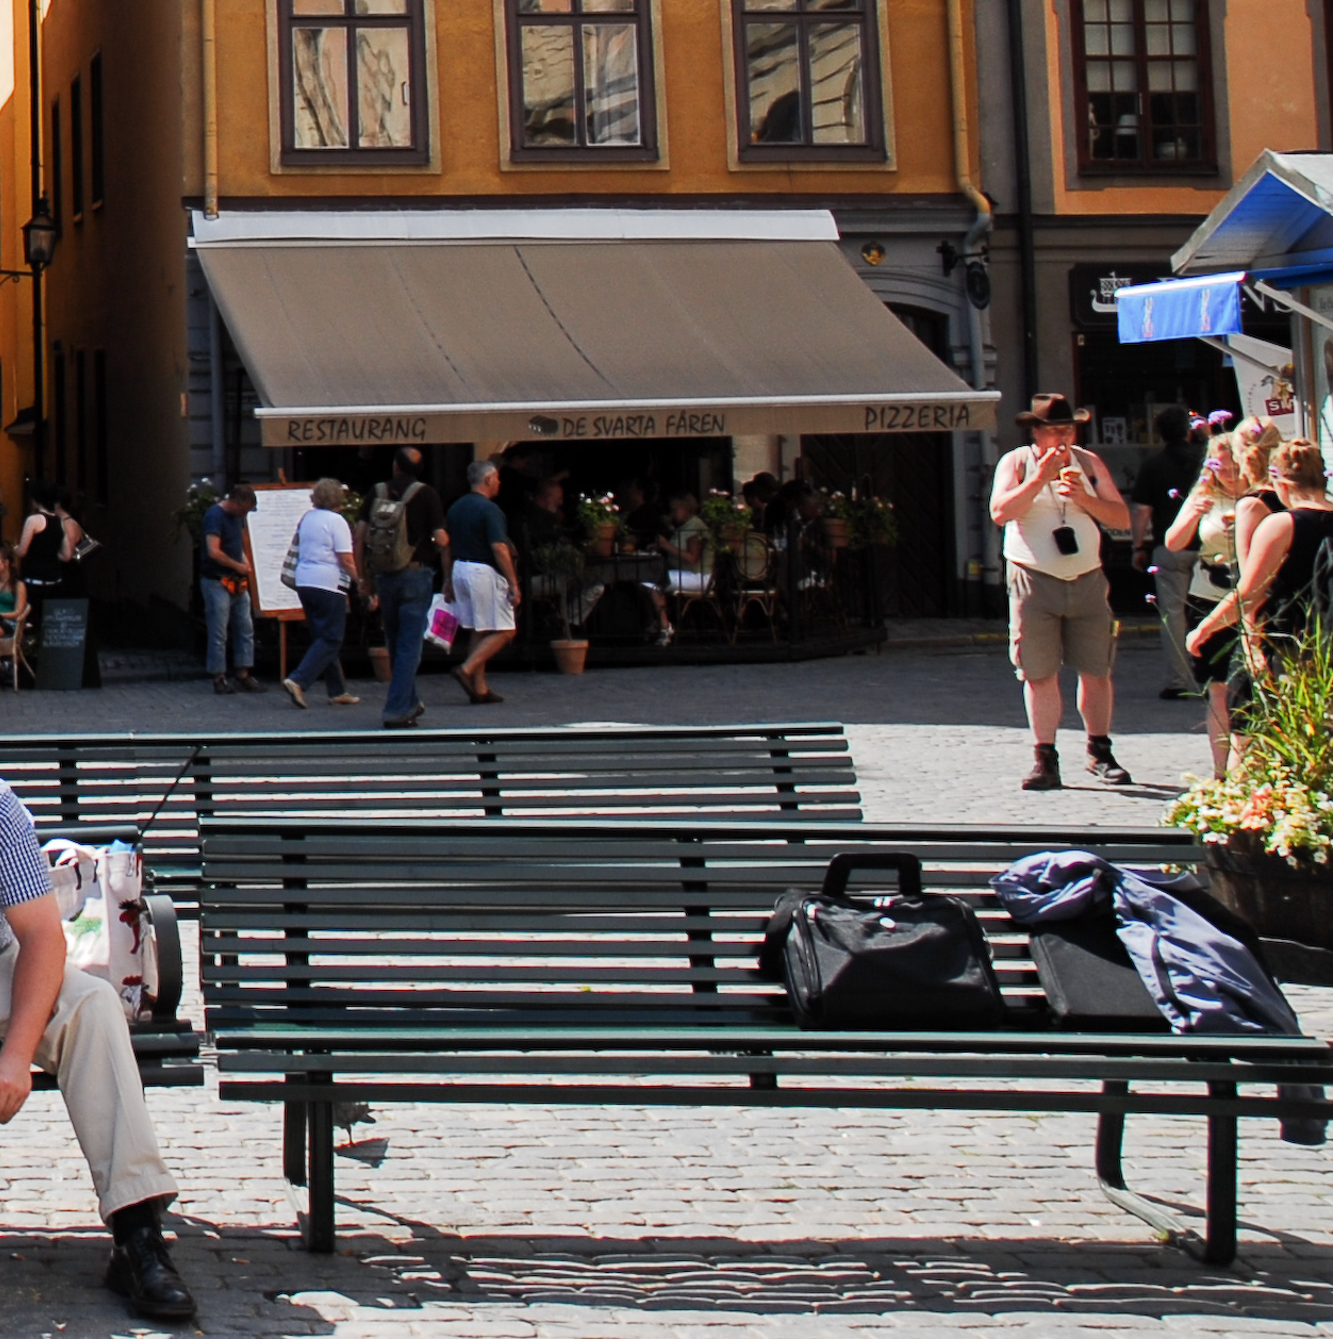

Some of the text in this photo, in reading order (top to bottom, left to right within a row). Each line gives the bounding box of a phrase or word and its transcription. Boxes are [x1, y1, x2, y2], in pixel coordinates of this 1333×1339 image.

[288, 417, 427, 442] RESTAURANG
[562, 410, 725, 437] DE SVARTA FÅREN
[864, 404, 970, 431] PIZZERIA
